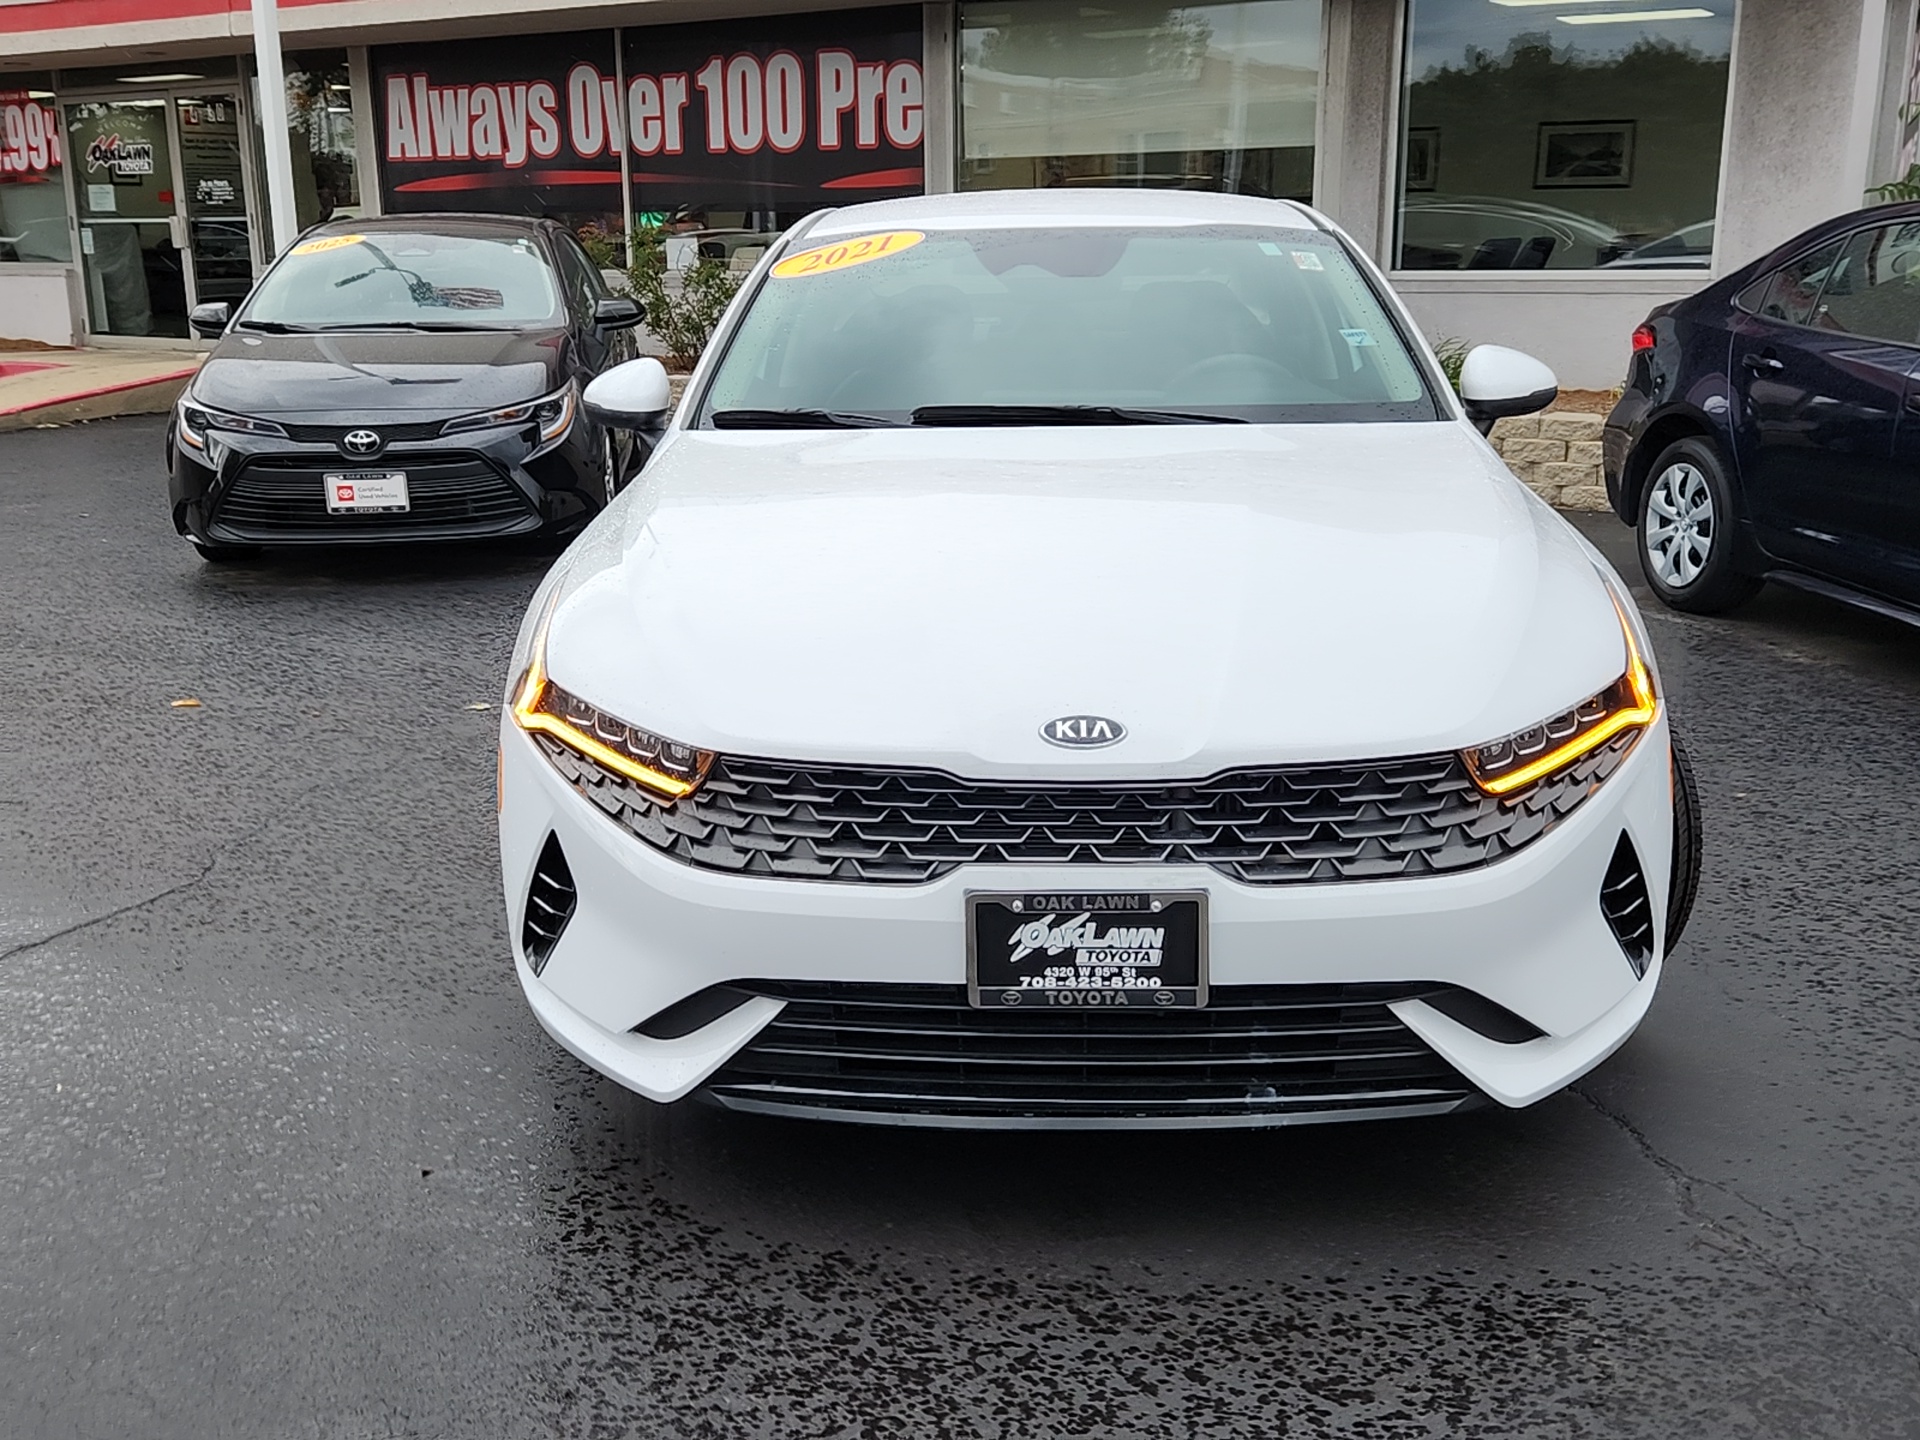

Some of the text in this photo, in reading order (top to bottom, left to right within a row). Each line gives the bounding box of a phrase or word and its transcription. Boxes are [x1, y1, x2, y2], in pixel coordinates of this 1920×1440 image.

[386, 48, 923, 168] Always Over 100 Pre
[0, 103, 61, 171] .99%
[120, 161, 149, 171] TOYOTA
[798, 234, 894, 273] 2021
[1055, 719, 1114, 739] KIA
[1033, 896, 1139, 910] OAK LAWN
[1086, 950, 1151, 963] TOYOTA
[1043, 966, 1137, 978] 4320 W 95th St
[1019, 976, 1162, 988] 708-423-5200
[1045, 990, 1129, 1005] TOYOTA
